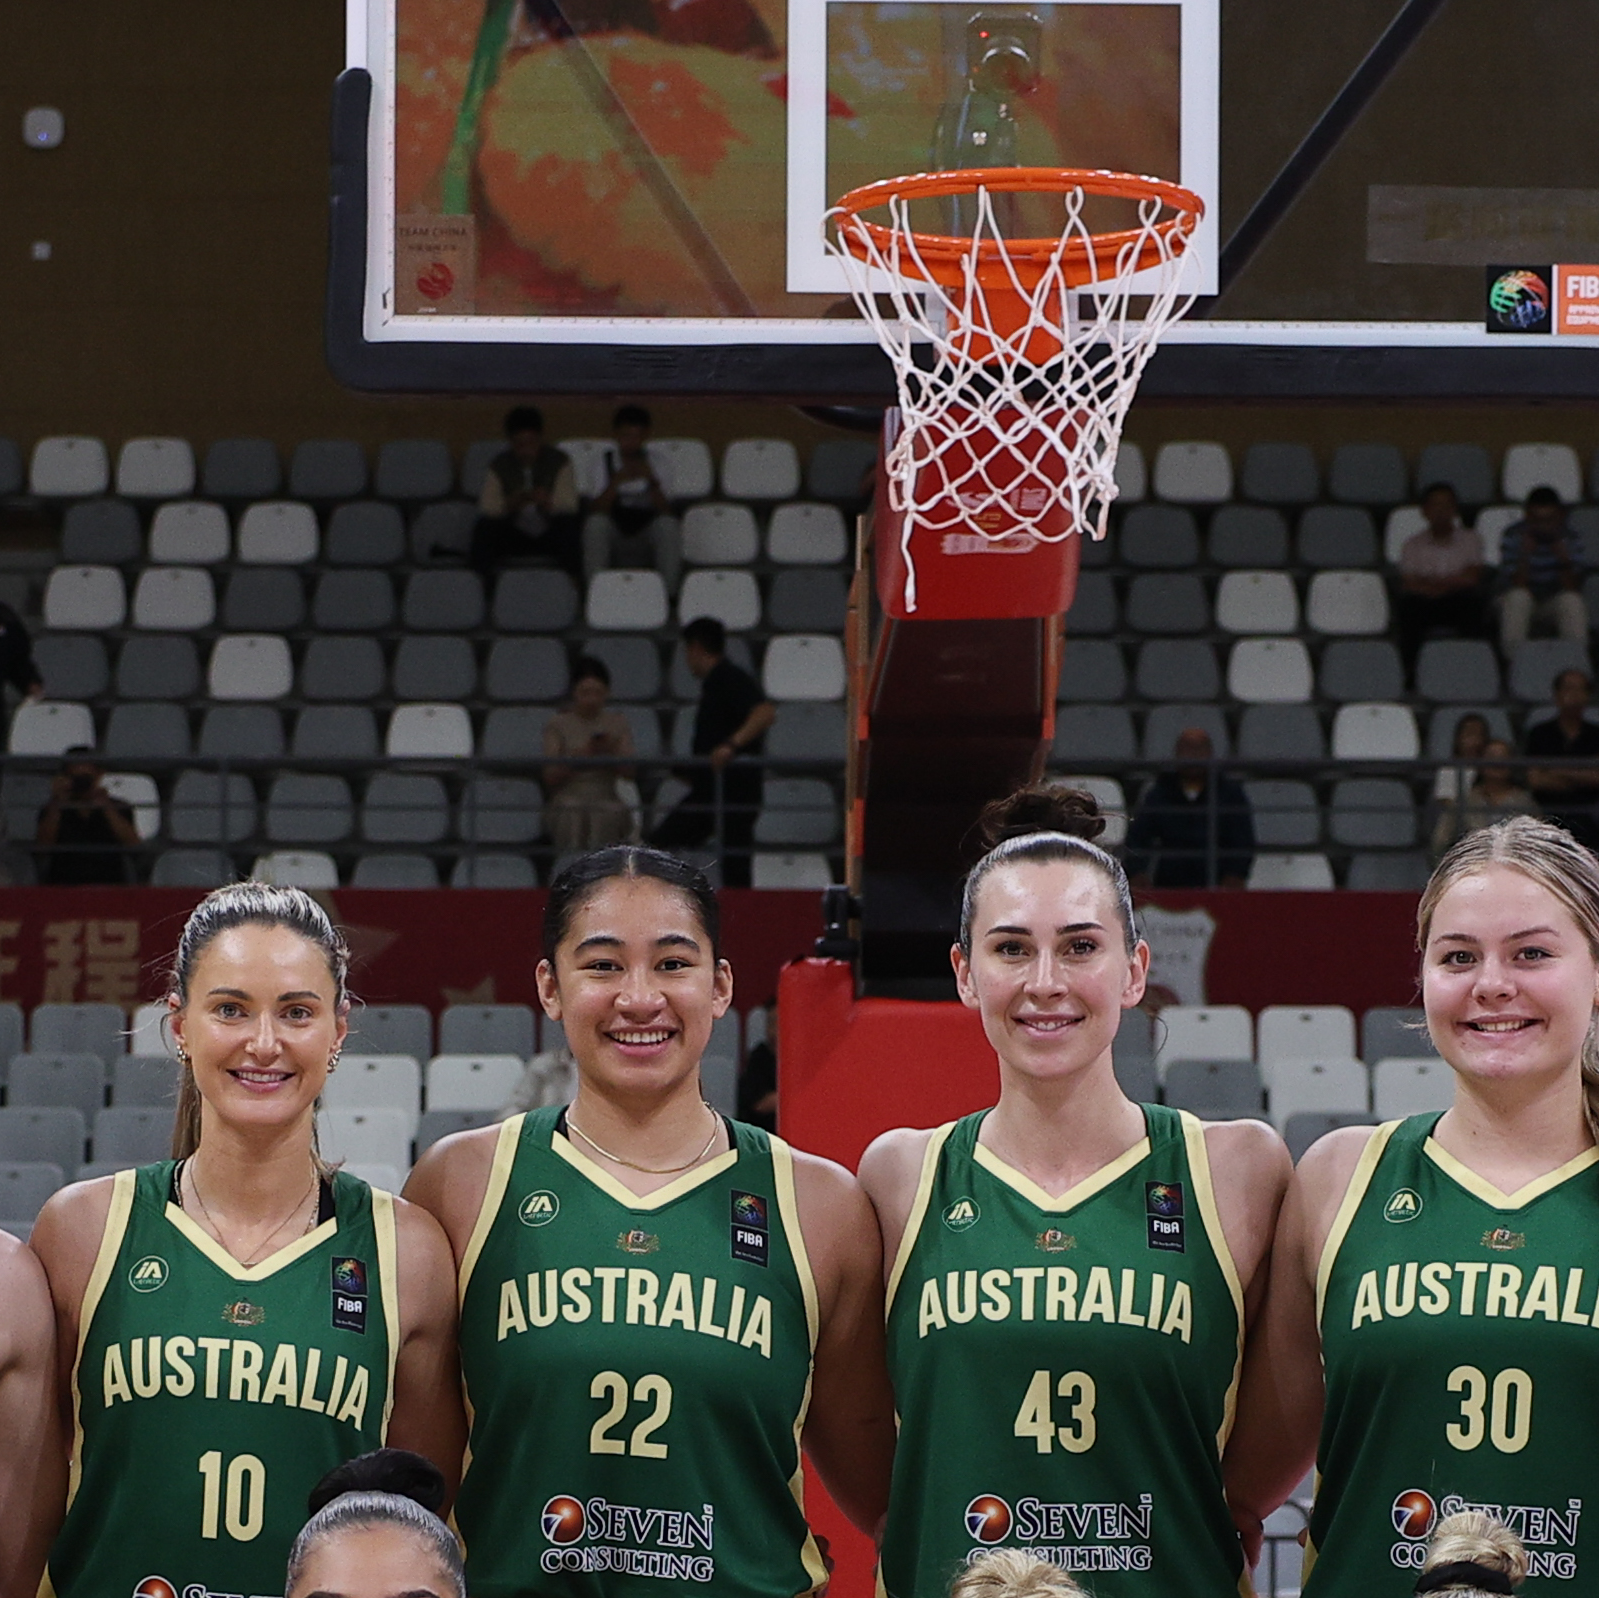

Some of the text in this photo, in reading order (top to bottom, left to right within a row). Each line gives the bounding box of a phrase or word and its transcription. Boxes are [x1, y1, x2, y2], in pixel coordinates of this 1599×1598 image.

[737, 1230, 763, 1247] FIBA
[1153, 1220, 1180, 1234] FIBA
[337, 1297, 363, 1314] FIBA
[497, 1267, 773, 1359] AUSTRALIA
[919, 1267, 1192, 1345] AUSTRALIA
[103, 1335, 370, 1432] AUSTRALIA
[589, 1370, 673, 1459] 22
[1014, 1370, 1097, 1454] 43
[1445, 1365, 1533, 1454] 30
[198, 1450, 267, 1542] 10
[587, 1498, 714, 1550] SEVEN
[1015, 1498, 1154, 1541] SEVEN
[541, 1546, 715, 1583] CONSULTING
